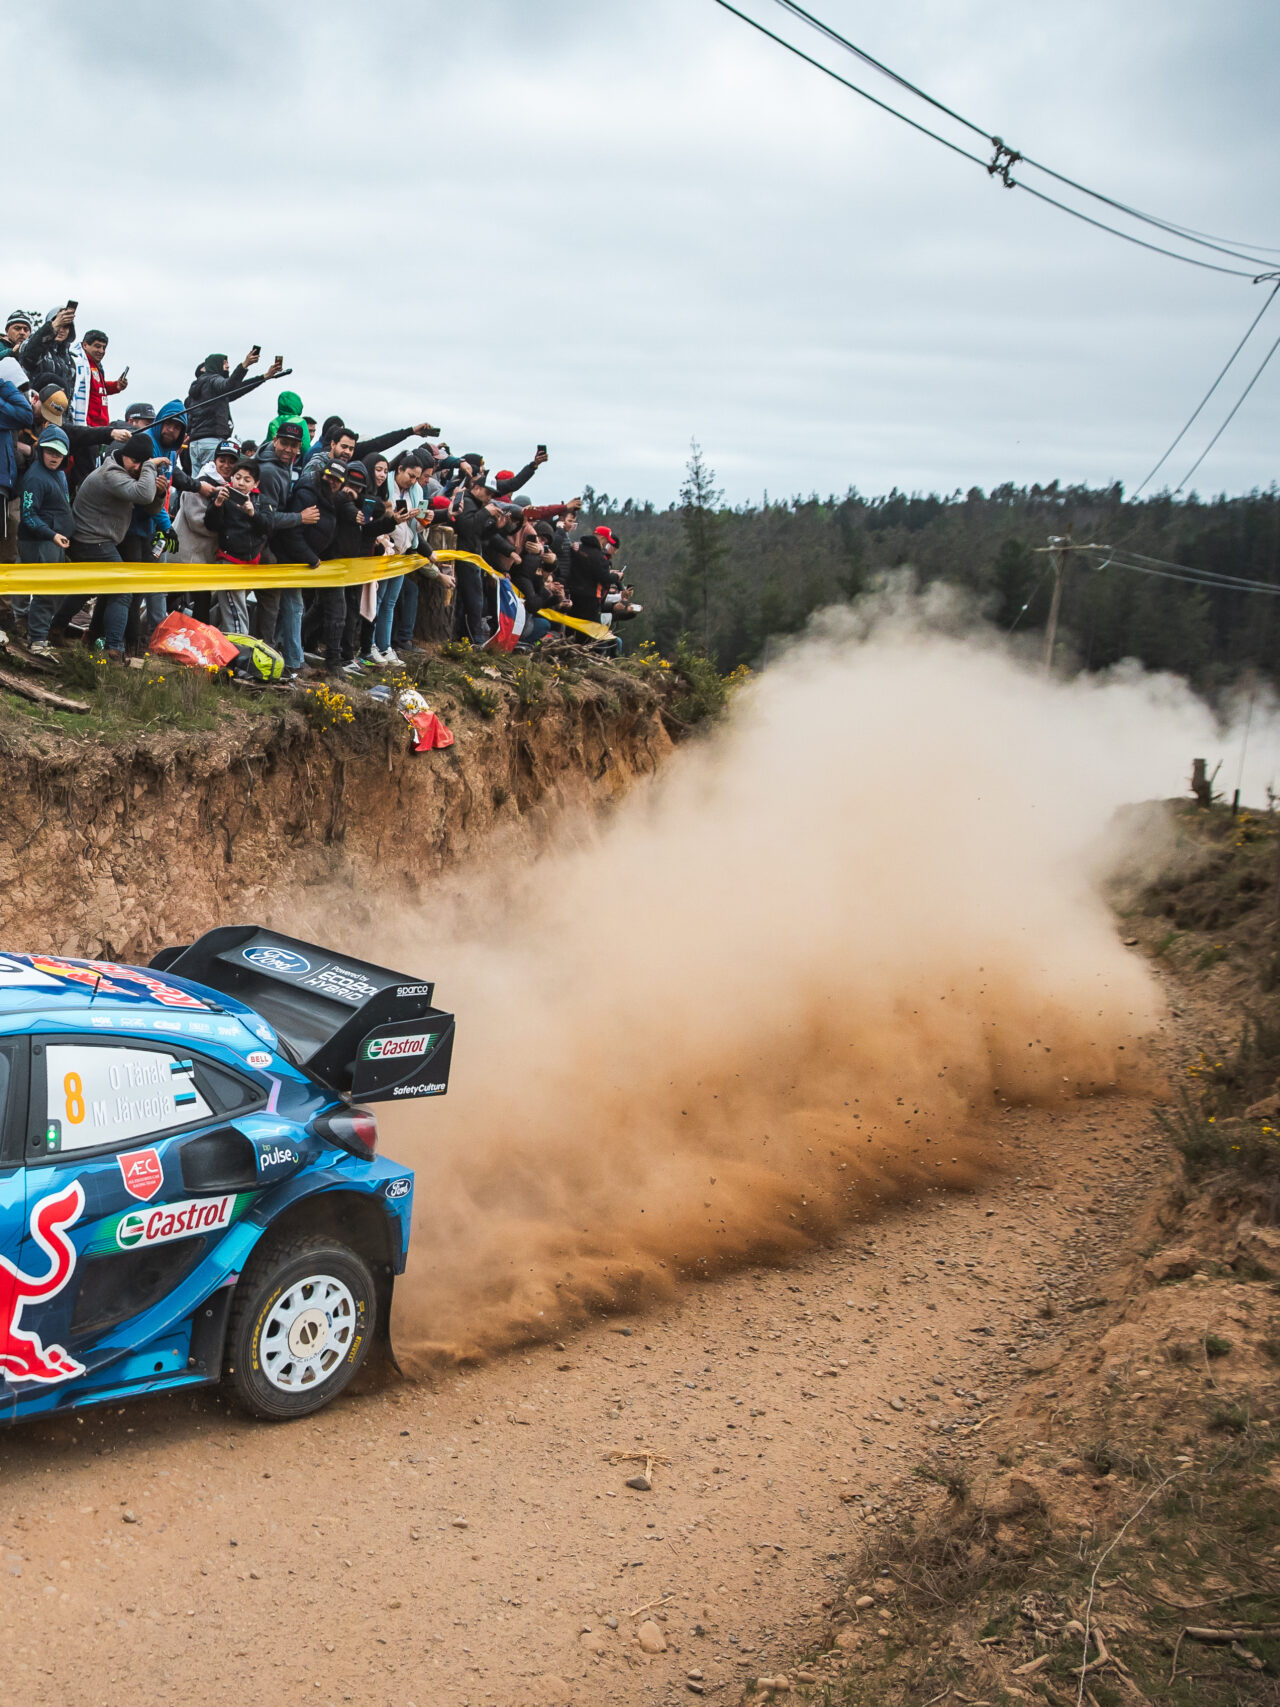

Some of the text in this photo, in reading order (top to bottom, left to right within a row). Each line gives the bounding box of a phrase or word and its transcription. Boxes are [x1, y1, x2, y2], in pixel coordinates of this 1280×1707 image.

[250, 949, 300, 972] Ford
[331, 966, 370, 982] Powered by
[304, 978, 363, 1001] HYBRID
[397, 985, 428, 996] sparco
[382, 1036, 425, 1056] Castrol
[250, 1055, 269, 1064] BELL
[109, 1059, 167, 1090] O Tänak
[64, 1072, 85, 1124] 8
[393, 1082, 446, 1096] SafetyCulture
[92, 1093, 172, 1127] M Järveoja
[260, 1146, 292, 1171] pulse
[146, 1195, 228, 1241] Castrol
